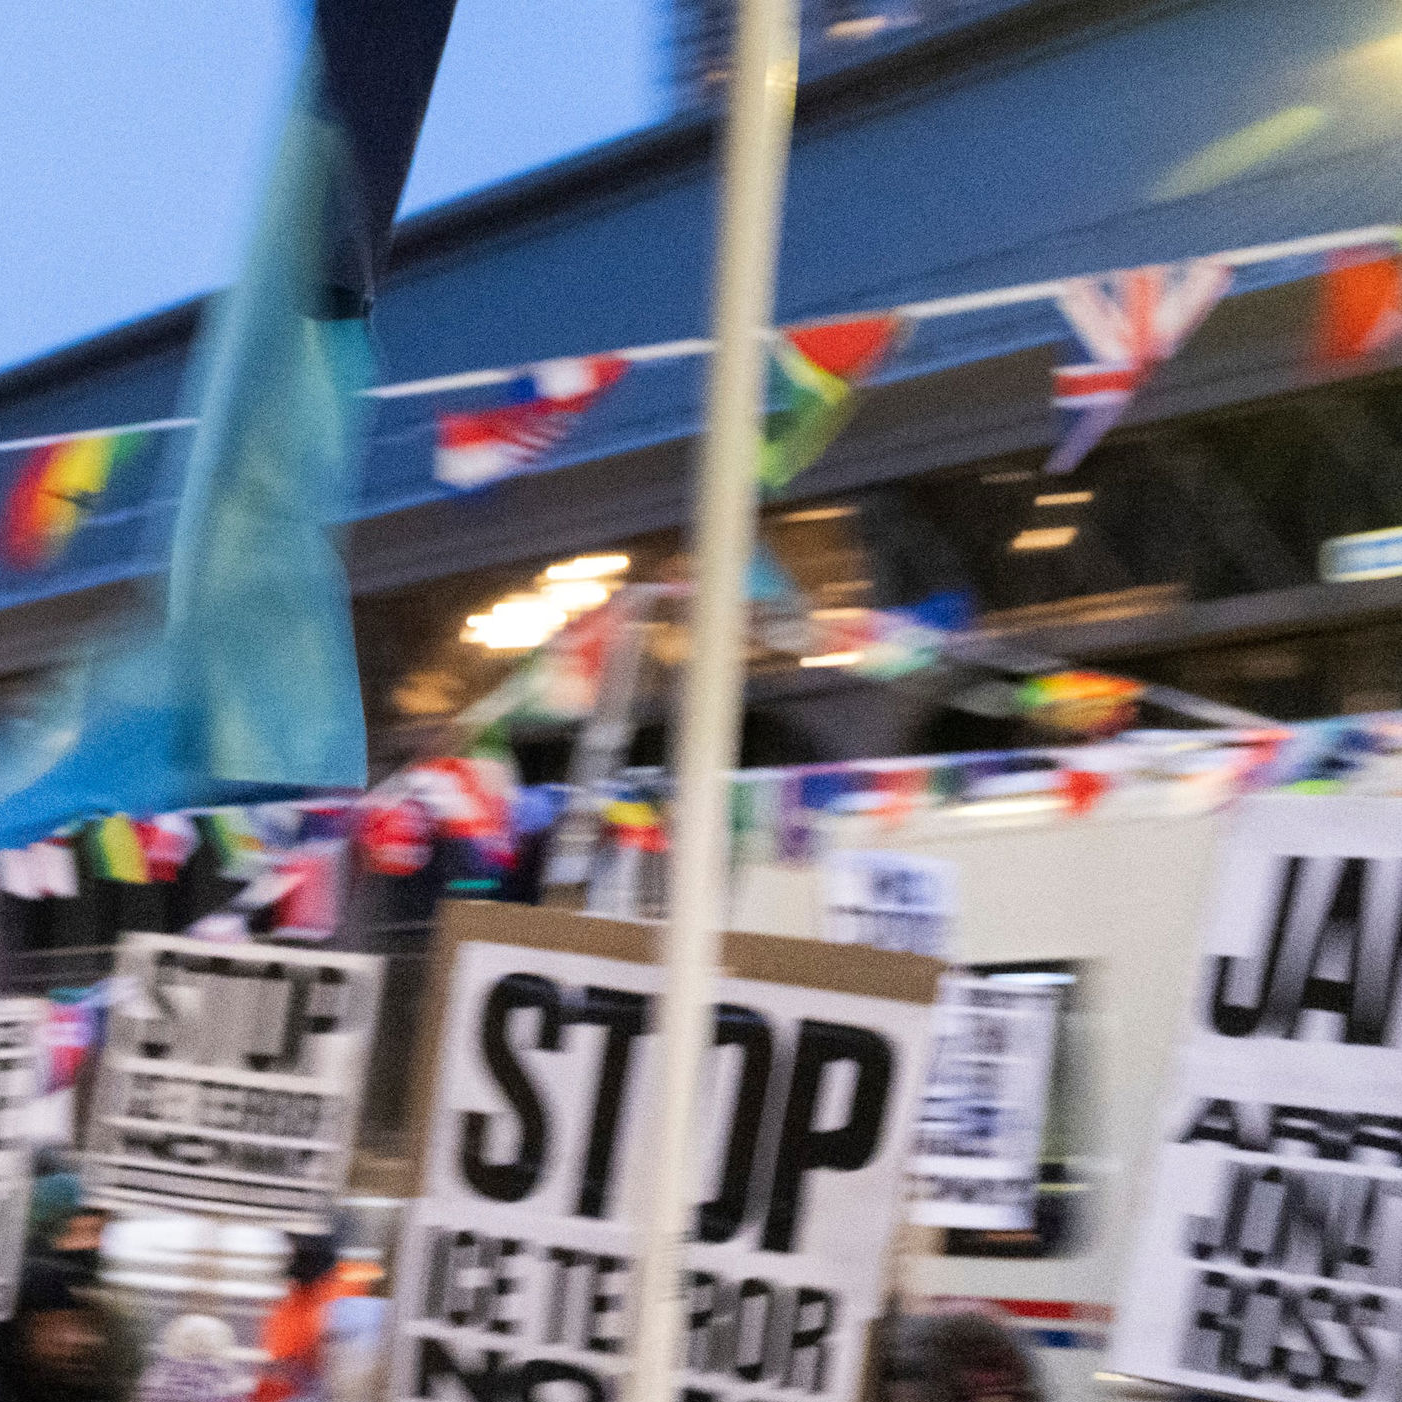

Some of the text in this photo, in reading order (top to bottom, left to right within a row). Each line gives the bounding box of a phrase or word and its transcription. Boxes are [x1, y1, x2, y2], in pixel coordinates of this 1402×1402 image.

[457, 970, 898, 1255] STOP
[426, 1228, 834, 1393] ICE TEROR
